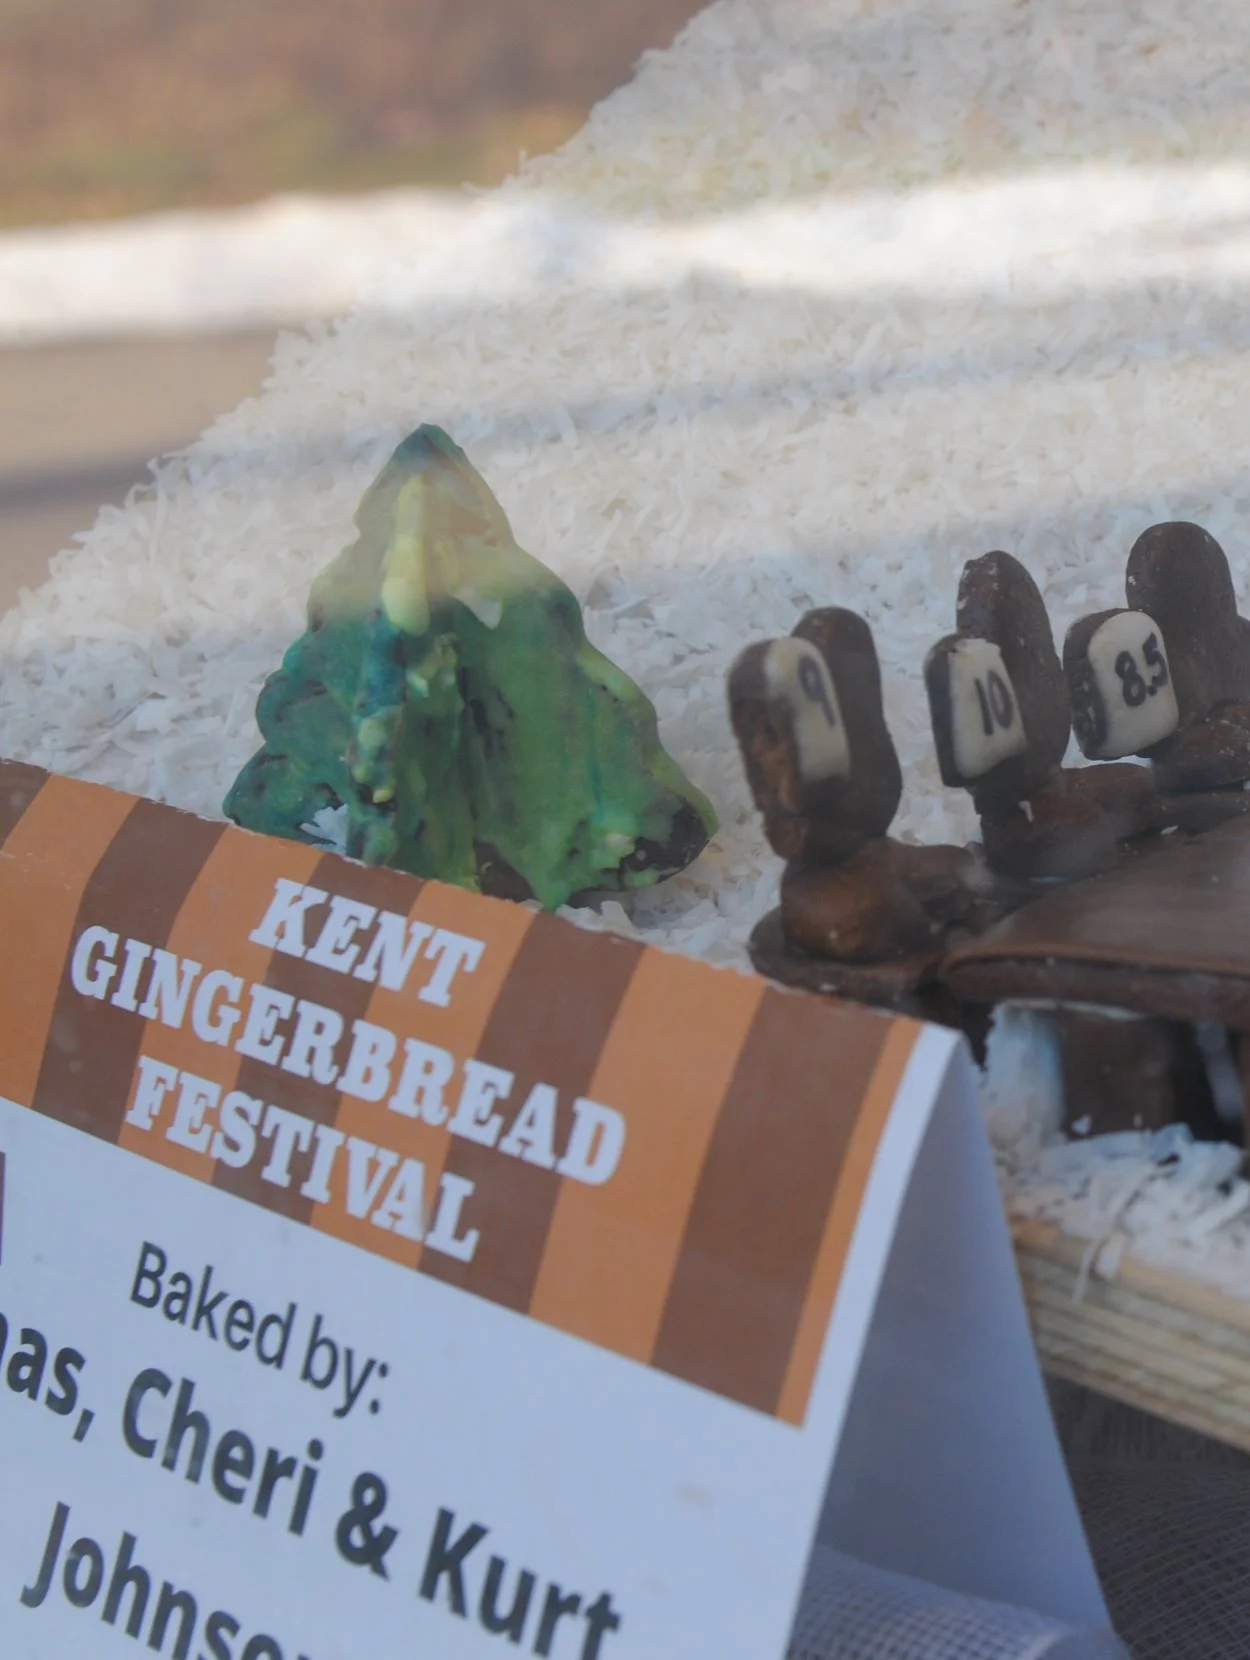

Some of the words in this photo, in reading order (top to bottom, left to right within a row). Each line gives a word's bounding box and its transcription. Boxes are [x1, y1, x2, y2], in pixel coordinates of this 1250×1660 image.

[797, 655, 836, 729] 9
[974, 669, 1014, 736] 10
[1114, 631, 1169, 707] 8.5
[248, 877, 486, 1008] KENT
[70, 925, 626, 1186] GINGERBREAD
[124, 1055, 481, 1263] FESTIVAL
[129, 1240, 297, 1370] Baked
[299, 1314, 390, 1419] by:
[0, 1311, 96, 1443] as,
[121, 1366, 325, 1537] Cheri
[334, 1470, 400, 1582] &
[418, 1506, 622, 1660] Kurt
